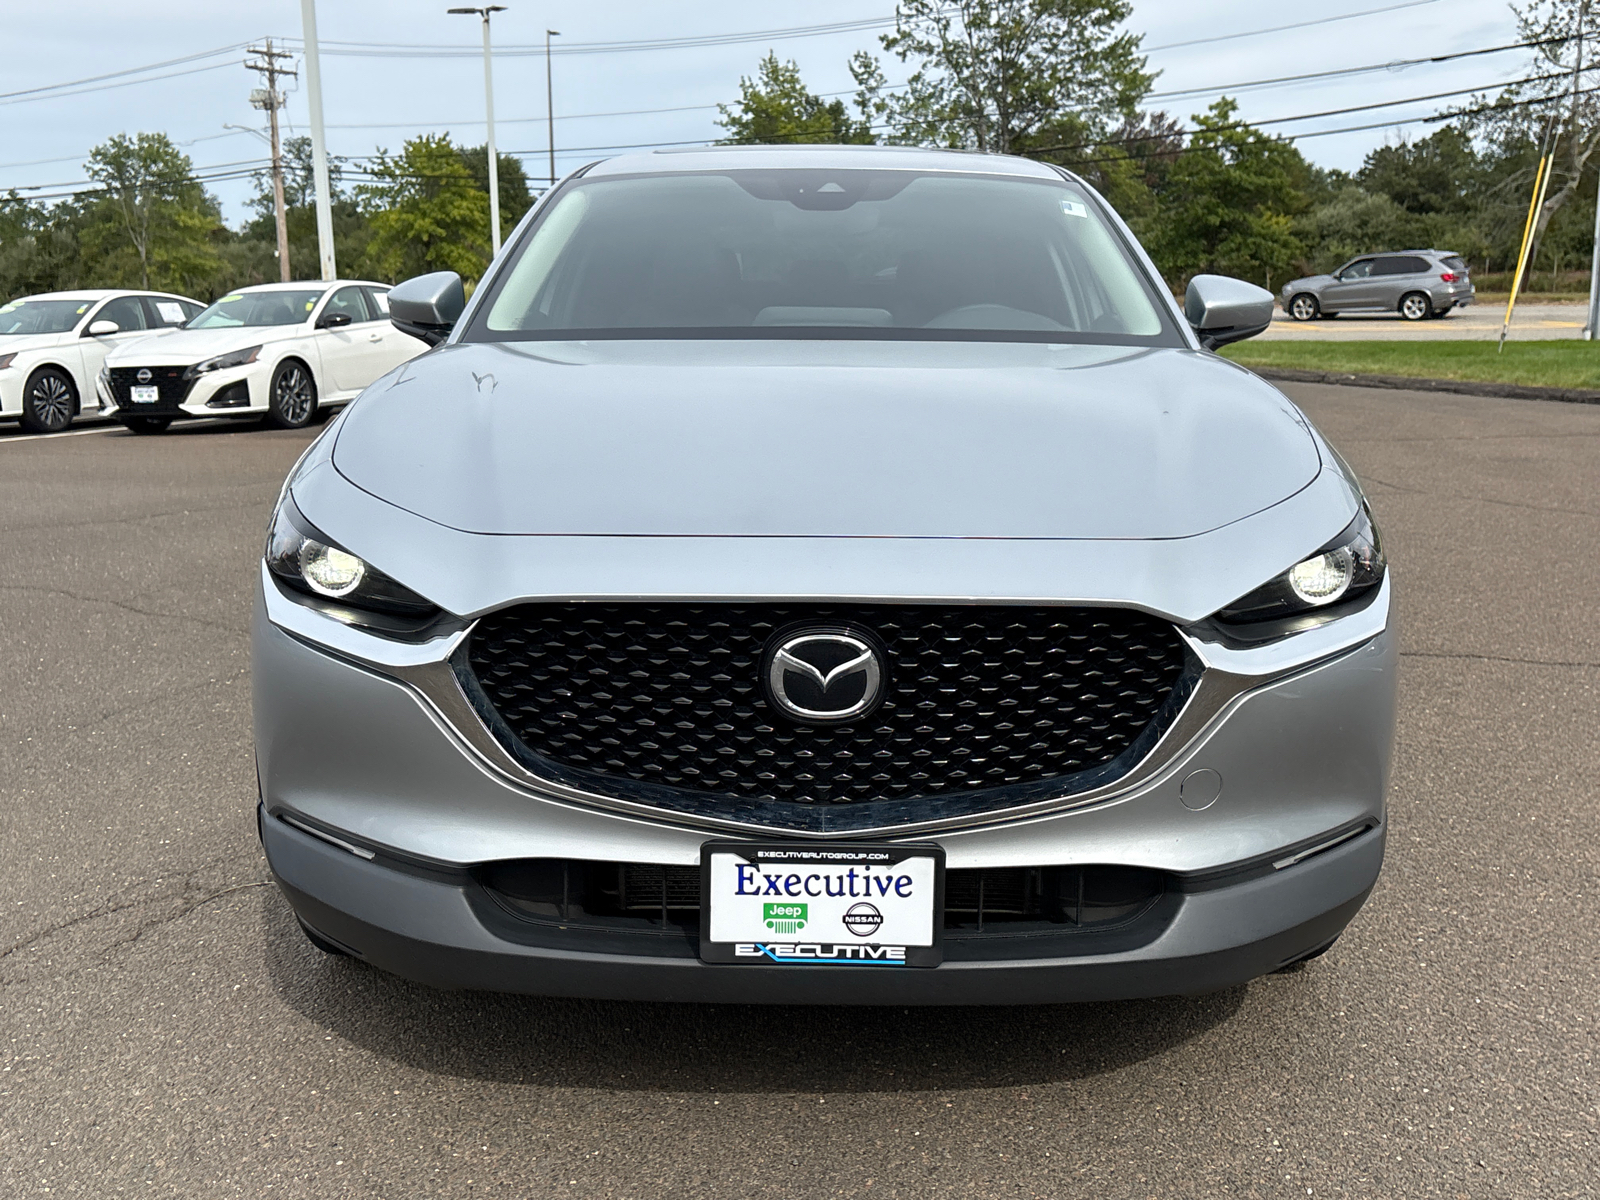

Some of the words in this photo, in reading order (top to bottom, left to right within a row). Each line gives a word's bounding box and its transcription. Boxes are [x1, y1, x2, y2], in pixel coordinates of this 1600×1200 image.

[757, 851, 889, 860] EXECUTIVEAUTOGROUP.COM
[735, 863, 913, 898] Executive
[769, 904, 802, 918] Jeep
[845, 916, 881, 924] NISSAN
[735, 943, 906, 961] EXECUTIVE
